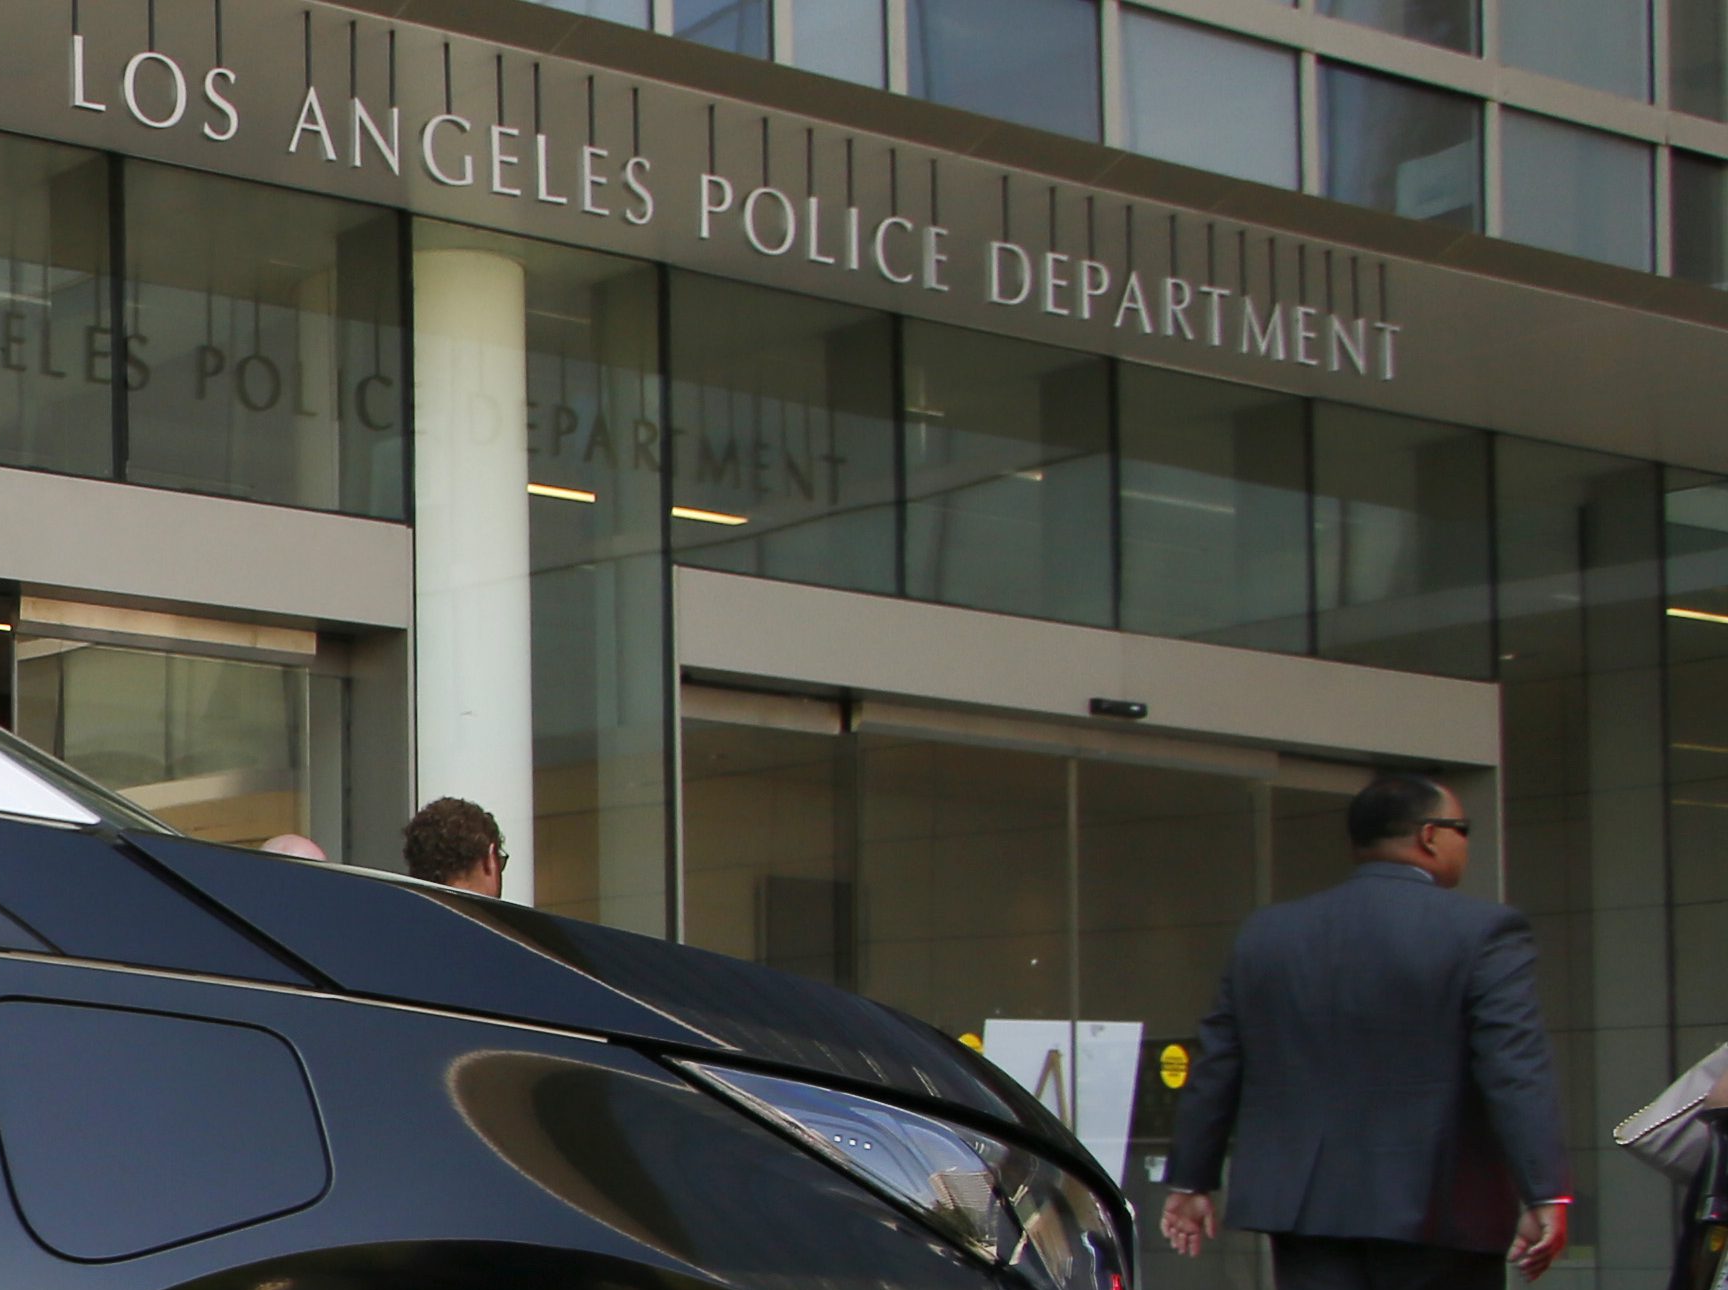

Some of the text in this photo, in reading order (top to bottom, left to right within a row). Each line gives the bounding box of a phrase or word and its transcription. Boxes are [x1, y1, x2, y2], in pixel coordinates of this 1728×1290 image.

[71, 34, 1402, 382] LOS ANGELES POLICE DEPARTMENT
